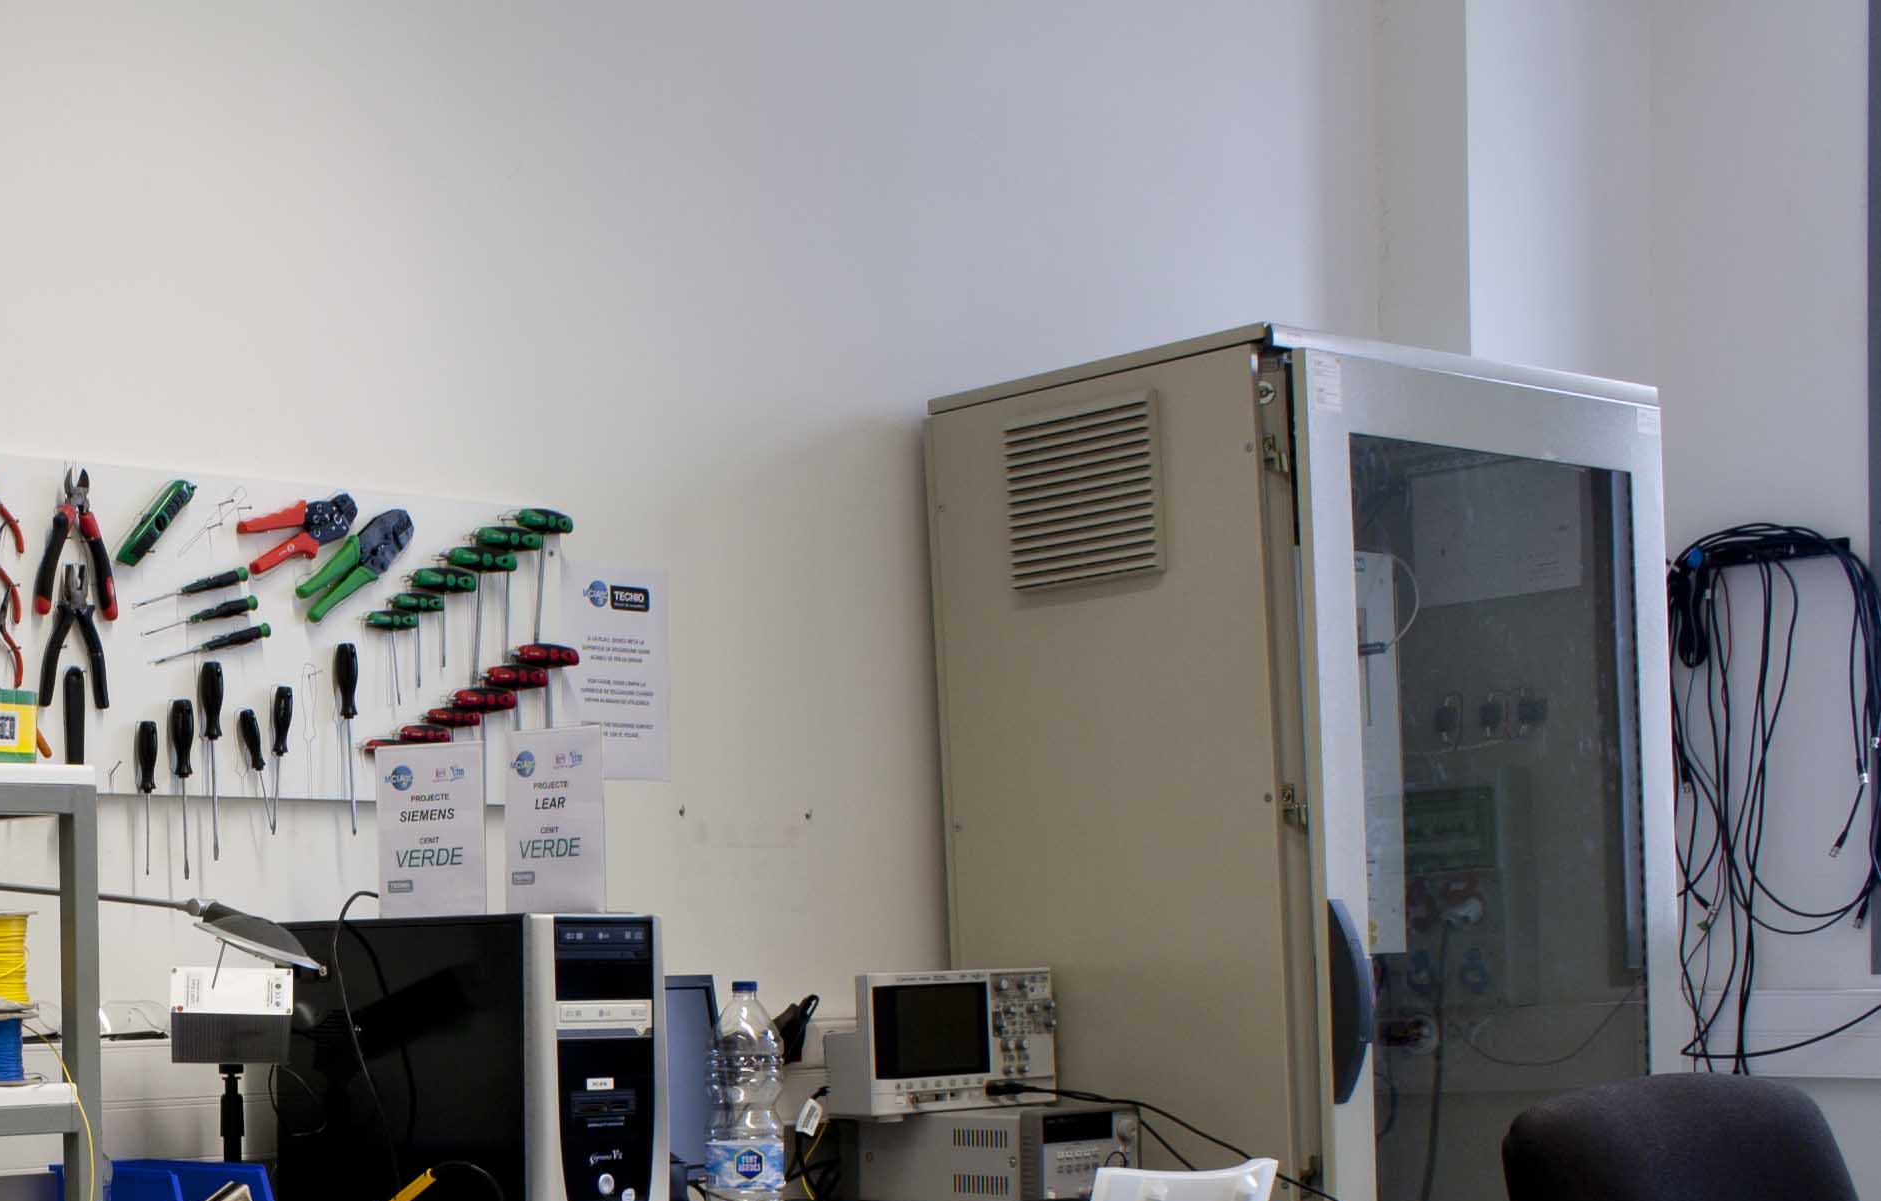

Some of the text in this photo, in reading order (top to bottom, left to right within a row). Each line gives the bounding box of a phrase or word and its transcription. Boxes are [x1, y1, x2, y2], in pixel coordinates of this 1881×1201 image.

[533, 780, 568, 790] PROJECTE
[410, 793, 450, 803] PROJECTE
[534, 796, 566, 810] LEAR
[399, 808, 455, 823] SIEMENS
[519, 837, 581, 859] VERDE
[395, 847, 463, 868] VERDE
